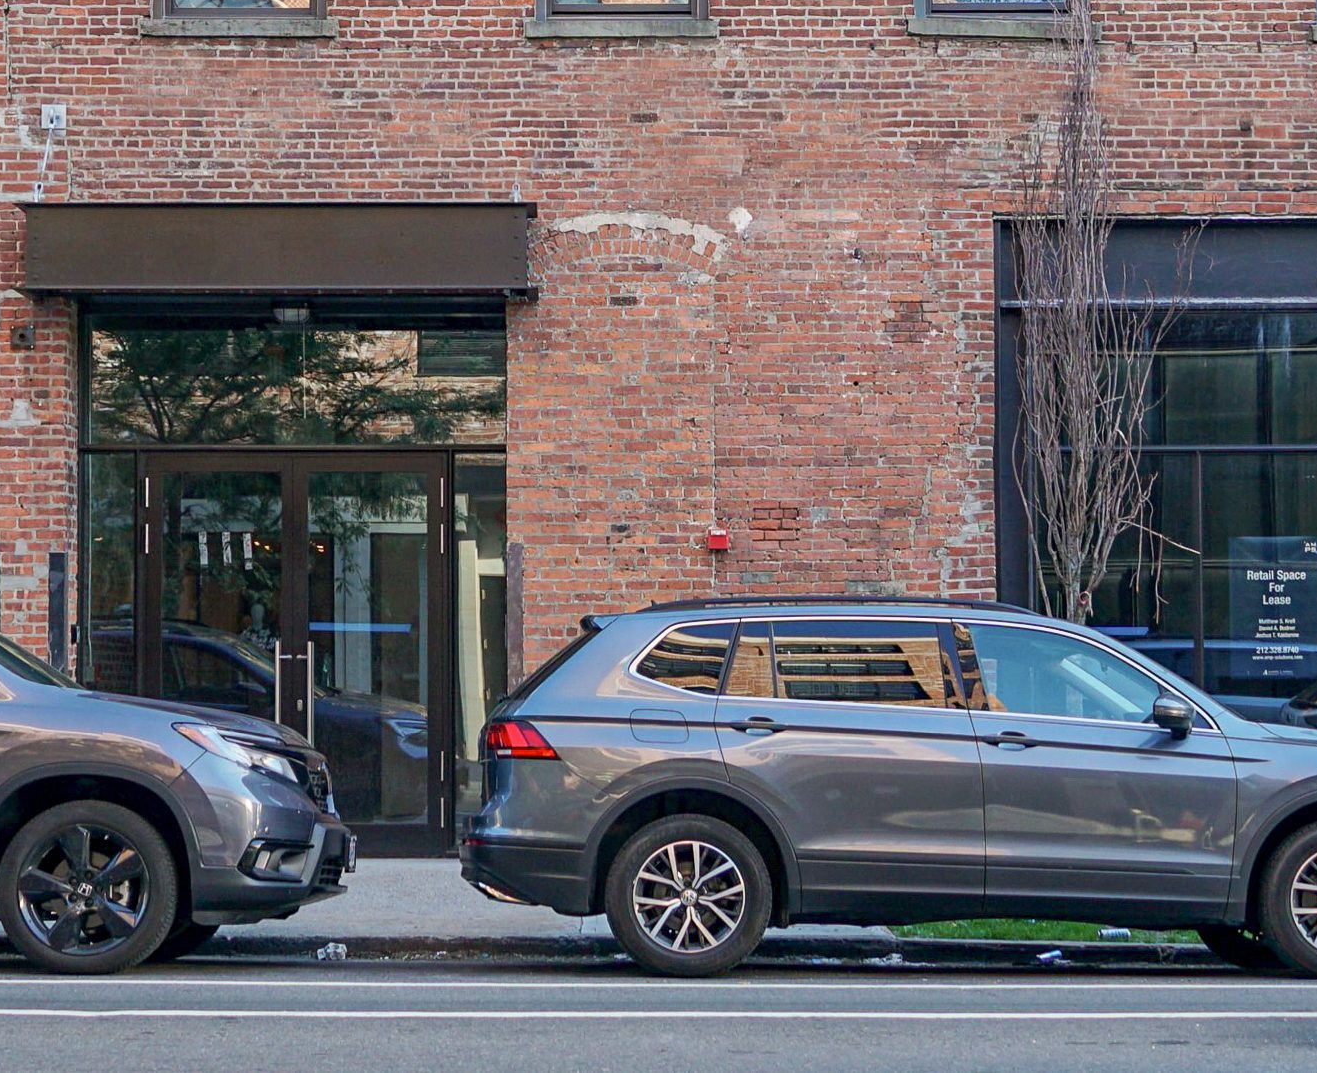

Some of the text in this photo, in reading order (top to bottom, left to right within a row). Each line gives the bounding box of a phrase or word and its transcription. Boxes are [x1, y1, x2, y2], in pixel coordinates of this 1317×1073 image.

[1247, 570, 1306, 582] Retail Space
[1269, 582, 1285, 592] For
[1263, 594, 1291, 605] Lease
